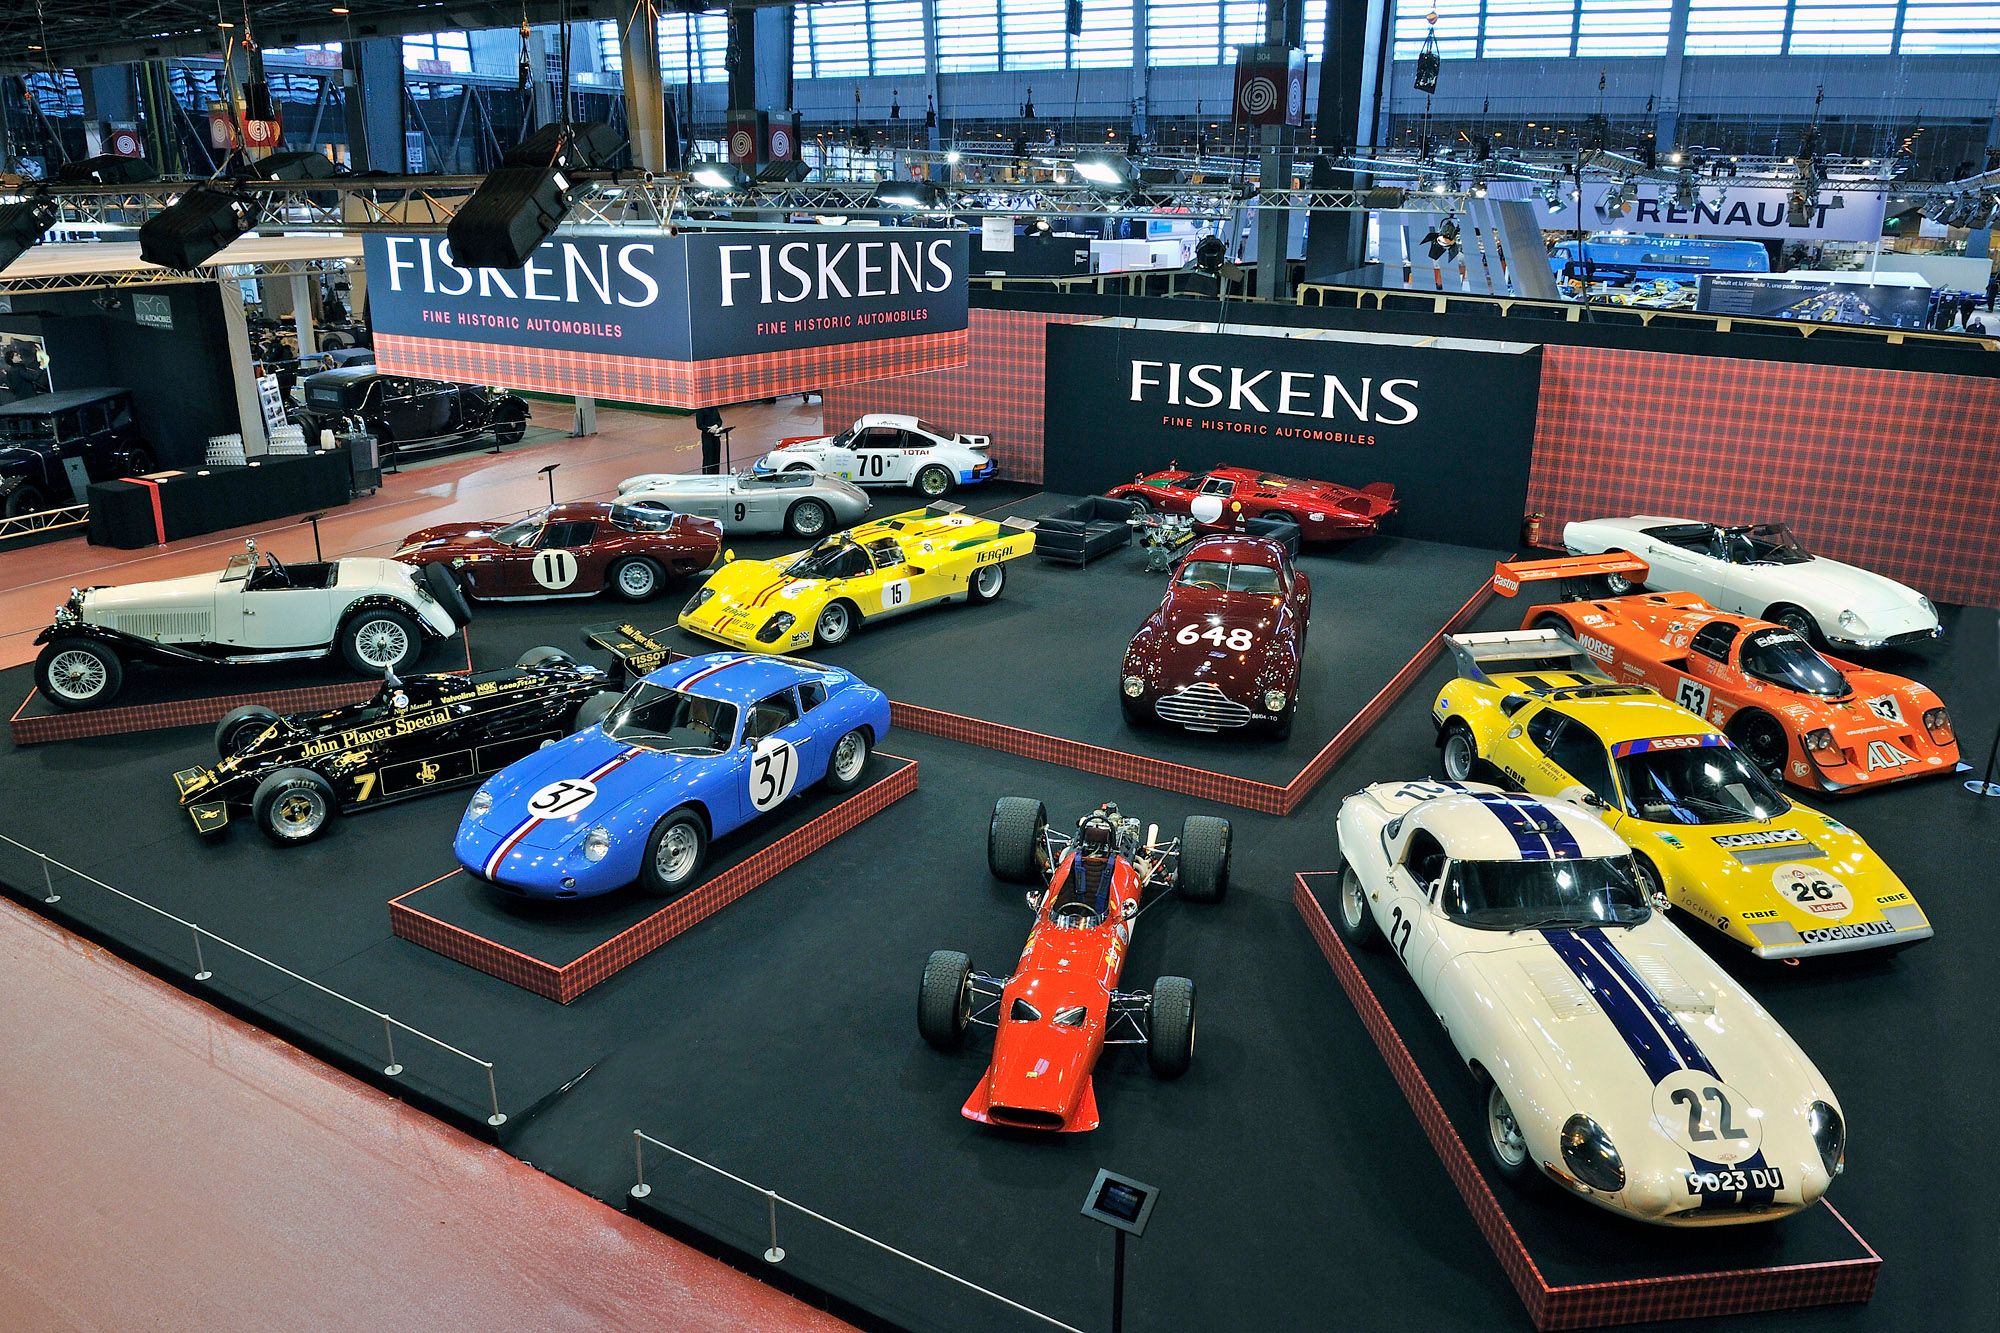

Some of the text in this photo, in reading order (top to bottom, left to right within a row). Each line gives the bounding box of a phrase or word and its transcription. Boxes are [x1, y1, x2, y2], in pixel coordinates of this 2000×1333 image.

[1636, 199, 1832, 228] RENAUT
[718, 239, 953, 307] FISKENS
[422, 310, 623, 338] FINE HISTORIC AUTOMOBILES
[757, 308, 928, 335] FINE HISTORIC AUTOMOBILES
[1130, 359, 1419, 425] FISKENS
[1163, 416, 1376, 446] FINE HISTORIC AUTOMOBILES
[856, 455, 883, 477] 70
[734, 503, 746, 521] 9
[544, 554, 566, 582] 11
[976, 545, 1014, 564] TERGAL
[890, 584, 902, 605] 15
[1494, 574, 1519, 591] Castrol
[1176, 624, 1254, 652] 648
[1579, 632, 1616, 660] MORSE
[630, 651, 667, 666] TISSOT
[410, 700, 433, 710] Mansell
[440, 691, 476, 705] Valvoline
[477, 682, 497, 692] NGK
[499, 678, 537, 690] GOODYEAR
[1681, 684, 1705, 716] 53
[301, 741, 339, 758] John
[341, 724, 392, 749] Player
[395, 707, 452, 736] Special
[1651, 737, 1700, 749] ESSO
[1867, 740, 1921, 772] ADA
[287, 779, 318, 790] AVON
[354, 772, 376, 802] 7
[754, 742, 790, 806] 37
[1504, 765, 1527, 786] CIBIE
[531, 782, 595, 813] 37
[1791, 880, 1833, 902] 26
[1877, 893, 1909, 904] CIBIE
[1681, 897, 1716, 921] JOCHEN
[1742, 910, 1780, 919] CIBIE
[1390, 906, 1412, 967] 22
[1803, 920, 1893, 944] COGIROUTE
[1670, 1087, 1749, 1142] 22
[1688, 1169, 1781, 1194] 9023 DU
